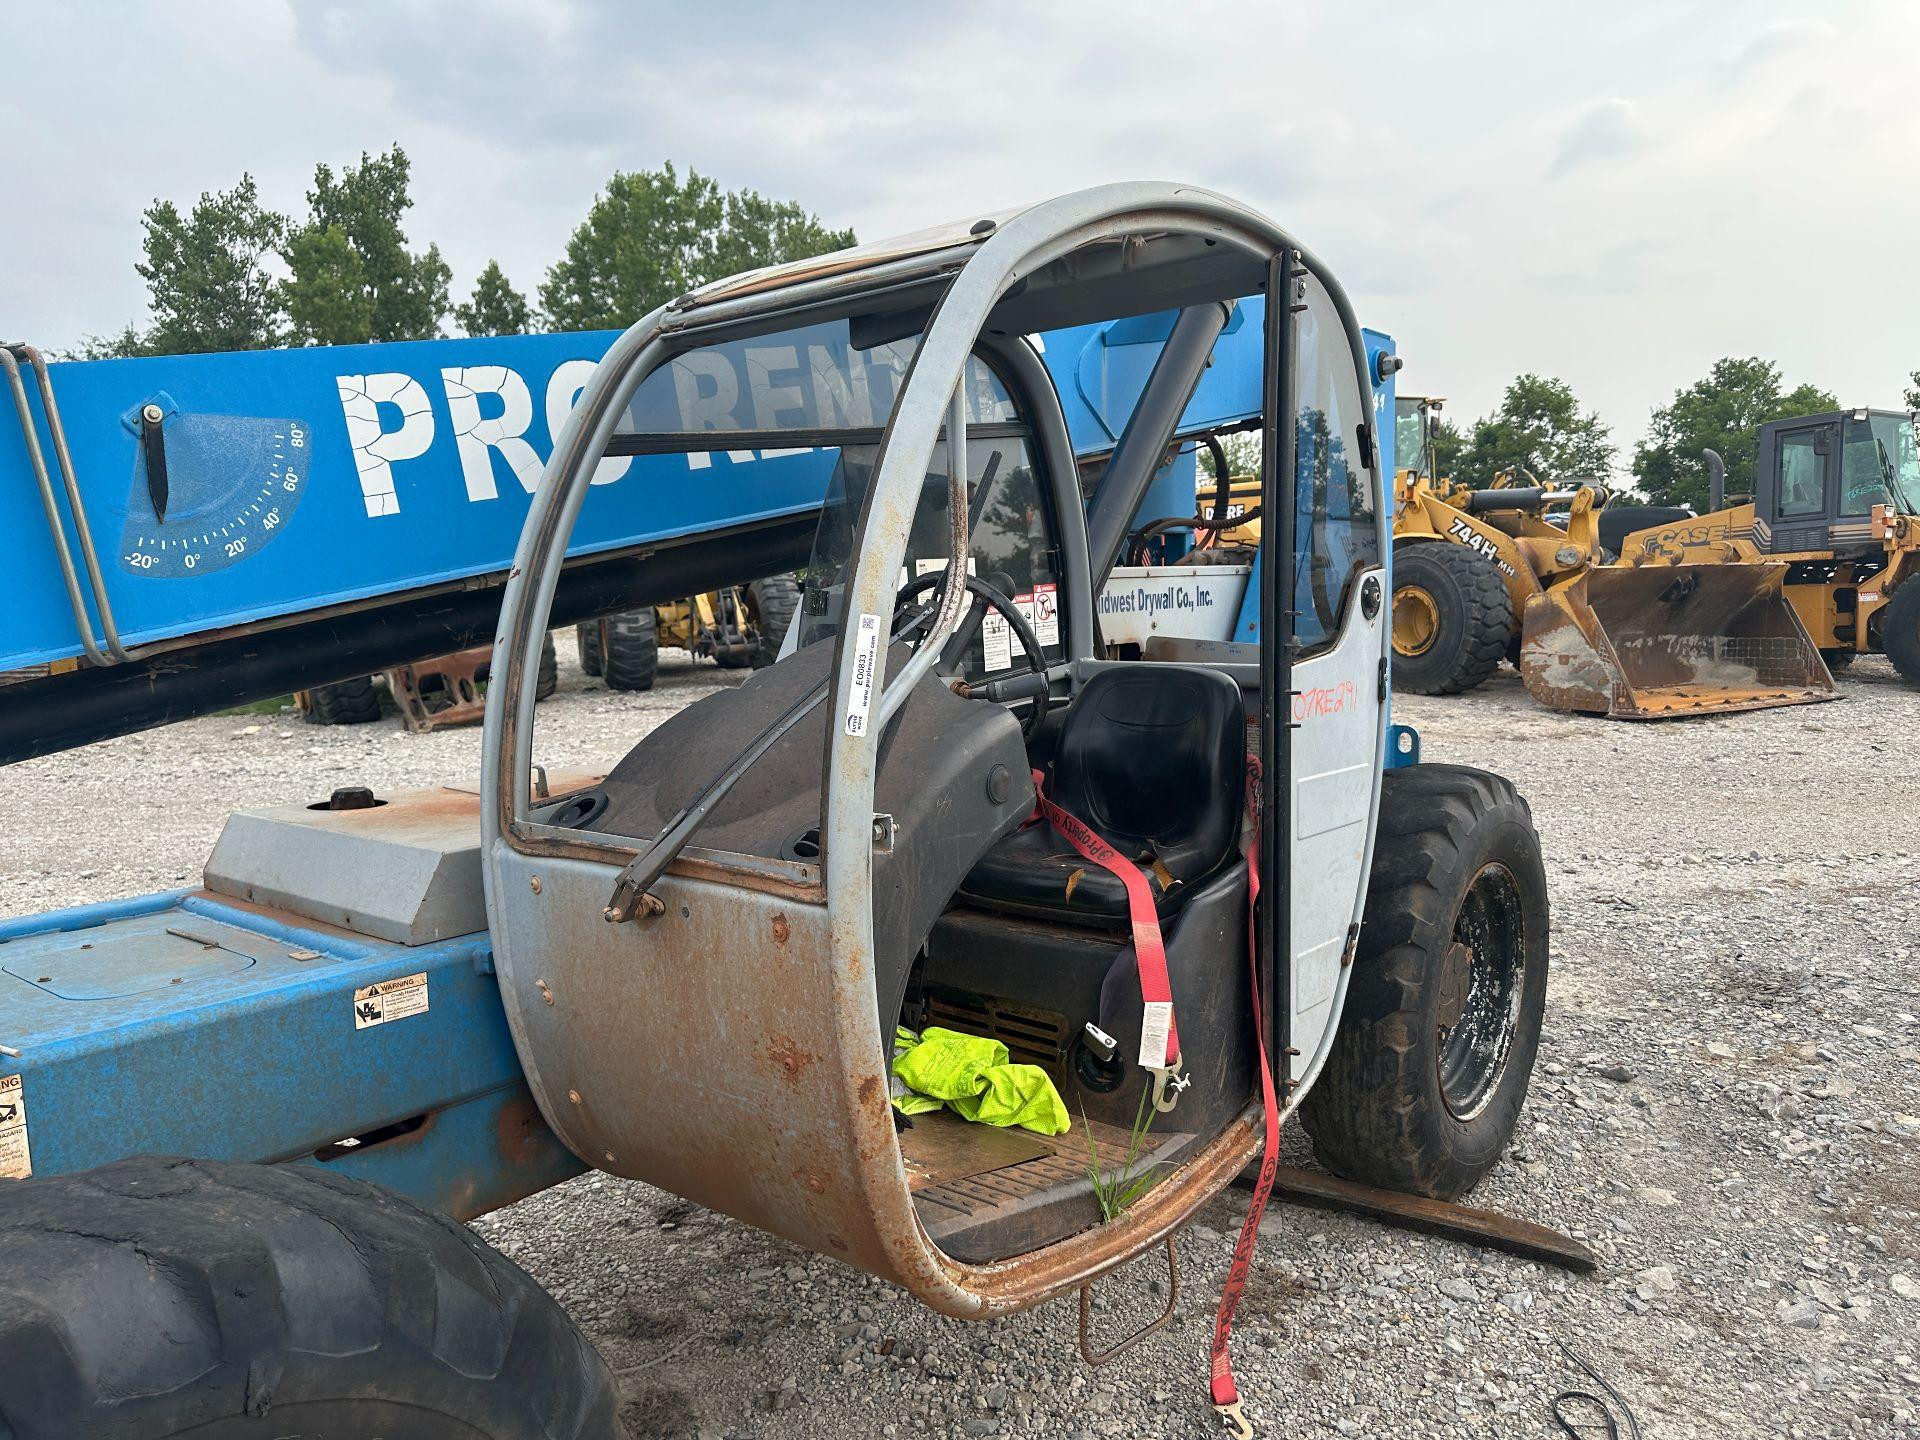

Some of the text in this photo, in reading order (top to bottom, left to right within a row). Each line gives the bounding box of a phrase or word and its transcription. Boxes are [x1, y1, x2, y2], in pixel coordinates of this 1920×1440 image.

[290, 422, 304, 448] 80°
[336, 359, 635, 518] PRO
[283, 466, 299, 492] 60°
[262, 507, 280, 531] 40°
[1205, 504, 1244, 520] DRE
[224, 536, 247, 557] 20°
[1448, 516, 1516, 577] 744H MH
[1656, 525, 1727, 546] CASE
[124, 552, 160, 569] -20°
[184, 553, 201, 569] 0°
[1138, 587, 1174, 616] Drywall
[1196, 585, 1213, 607] Inc.
[1061, 815, 1103, 856] Property
[381, 978, 414, 992] WARNING
[1234, 1183, 1272, 1262] Property
